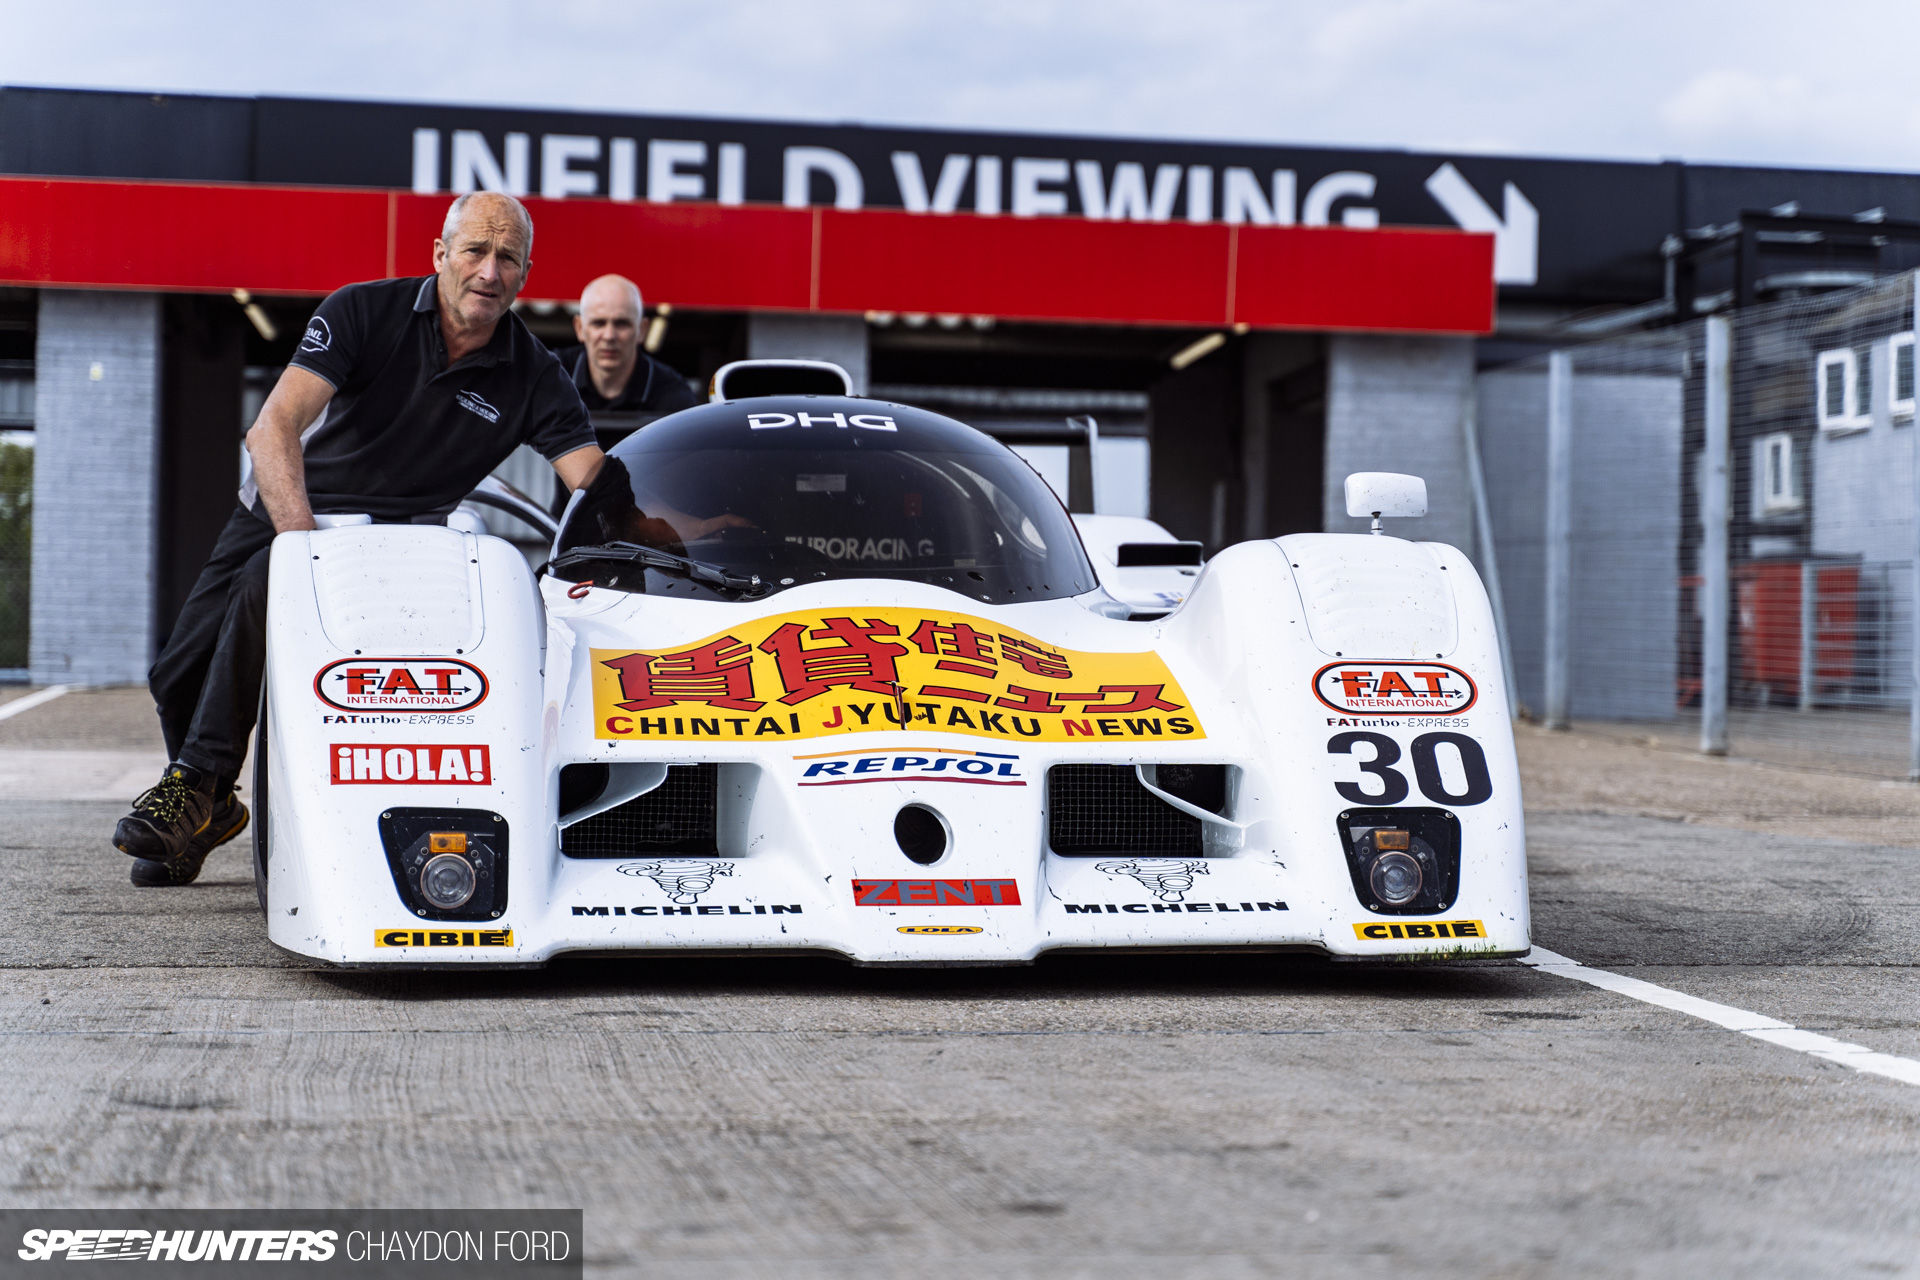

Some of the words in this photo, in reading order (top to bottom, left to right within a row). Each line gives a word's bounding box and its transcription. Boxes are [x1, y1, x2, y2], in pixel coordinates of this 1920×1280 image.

[412, 128, 864, 210] INFIELD
[891, 151, 1380, 229] VIEWING
[747, 412, 898, 432] DHG
[346, 668, 462, 695] F.A.T.
[1340, 671, 1454, 698] F.A.T.
[347, 696, 459, 705] INTERNATIONAL
[917, 684, 1185, 714] ニュース
[1346, 699, 1452, 707] INTERNATIONAL
[606, 712, 800, 736] CHINTAI
[821, 702, 1041, 737] JYUTAKU
[1065, 717, 1194, 737] NEWS
[338, 747, 484, 782] ¡HOLA!
[803, 757, 1021, 776] REPSOL
[1327, 731, 1493, 806] 30
[857, 880, 1015, 905] ZENT
[571, 904, 803, 917] MICHELIN
[1063, 901, 1289, 914] MICHELIN
